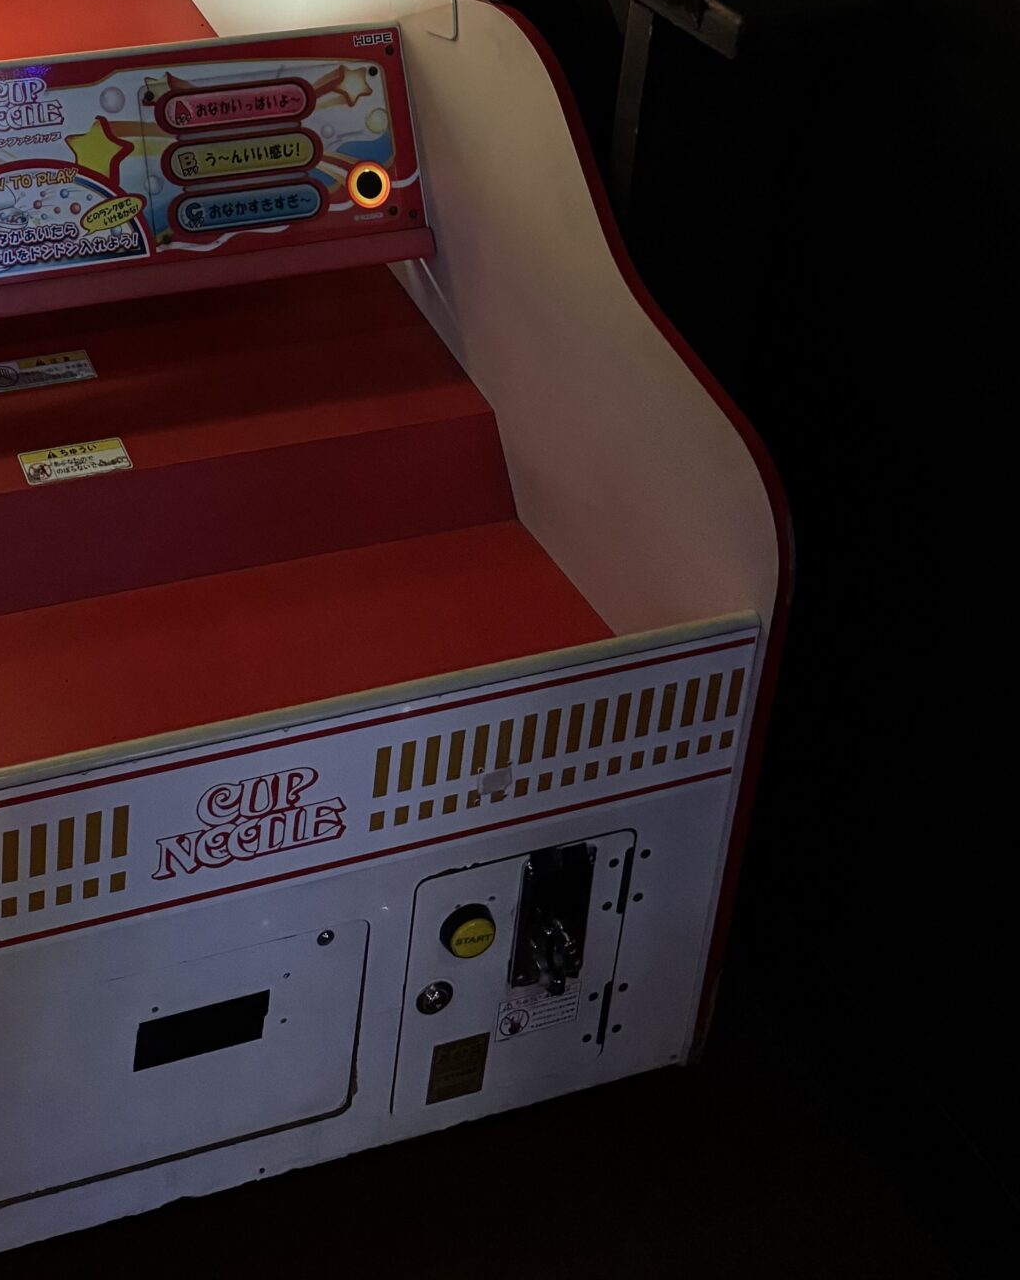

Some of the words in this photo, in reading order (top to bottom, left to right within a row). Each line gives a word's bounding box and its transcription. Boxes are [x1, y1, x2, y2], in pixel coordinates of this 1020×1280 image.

[353, 32, 392, 48] HOPE
[11, 174, 32, 189] TO
[36, 168, 78, 187] PLAY
[60, 444, 97, 457] ちゅうい
[196, 766, 319, 827] CUP
[151, 796, 347, 880] NOODLE
[455, 933, 492, 946] START
